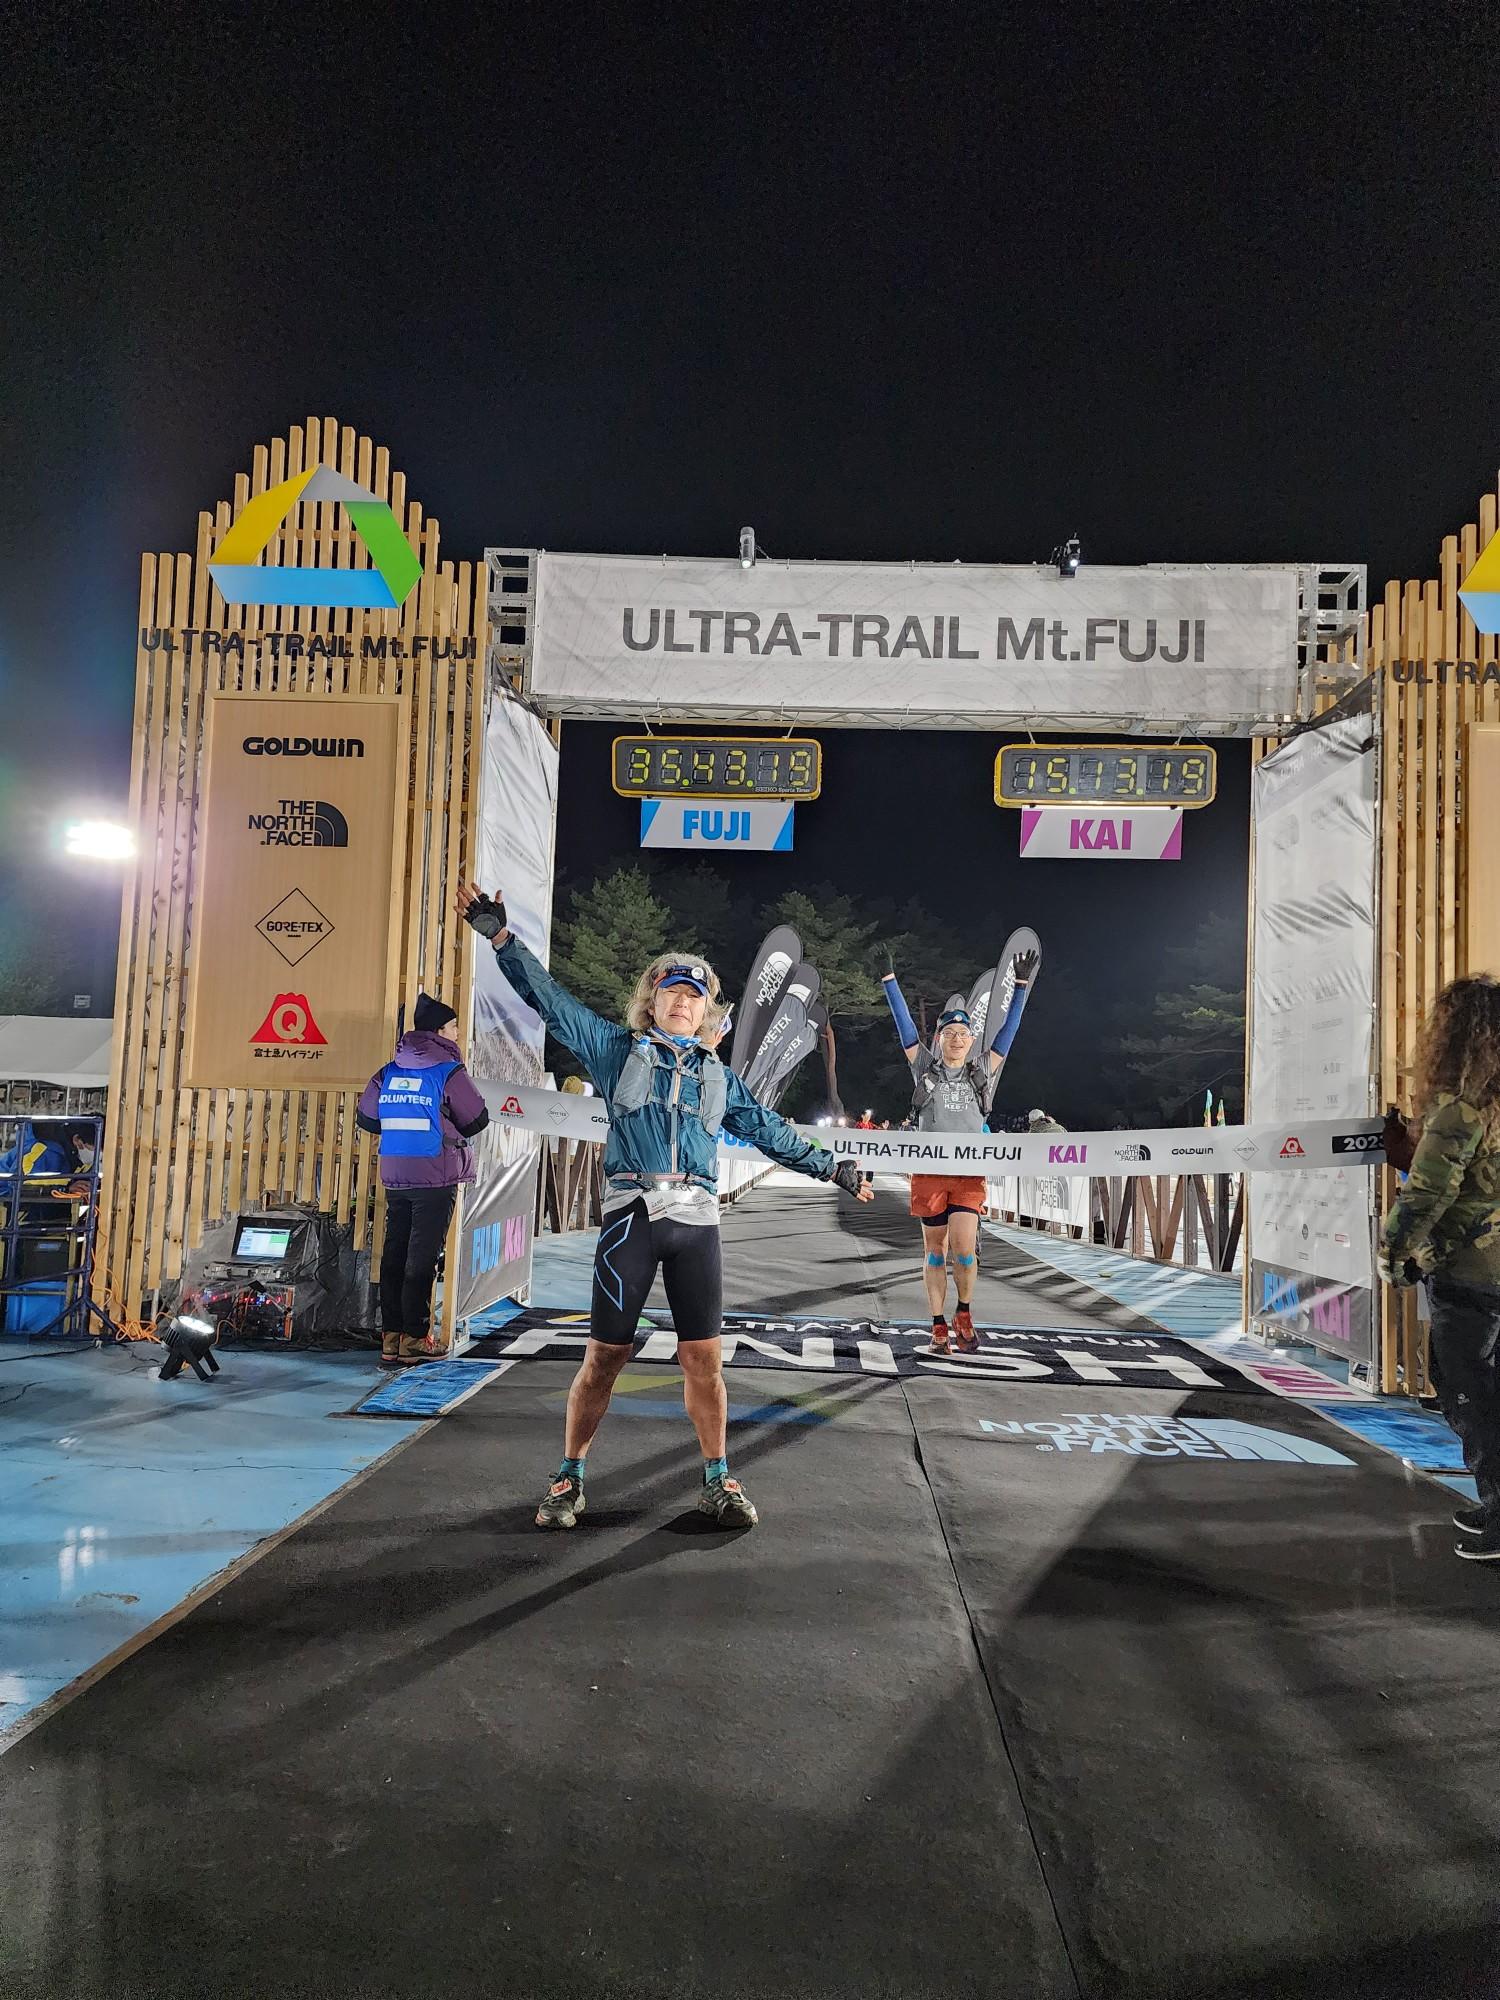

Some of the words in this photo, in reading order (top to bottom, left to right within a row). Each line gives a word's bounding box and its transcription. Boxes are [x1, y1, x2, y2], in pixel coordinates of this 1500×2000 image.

[141, 627, 354, 658] ULTRA-TRAIL
[363, 635, 477, 660] Mt.FUJI
[622, 607, 979, 660] ULTRA-TRAIL
[997, 616, 1205, 663] Mt.FUJI
[278, 800, 314, 815] THE
[248, 814, 314, 831] NORTH
[683, 810, 750, 841] FUJI
[1069, 819, 1132, 850] KAI
[266, 920, 323, 933] GORE-TEX
[757, 961, 774, 984] THE
[755, 970, 779, 1007] NORTH
[254, 1048, 324, 1060] 富士急ハイランド
[834, 1140, 949, 1159] ULTRA-TRAIL
[954, 1146, 1021, 1161] Mt.FUJI
[1048, 1145, 1088, 1164] KAI
[471, 1222, 501, 1278] FUJI
[504, 1214, 527, 1265] KAI
[978, 1419, 1202, 1441] NORTH
[1061, 1413, 1184, 1427] THE
